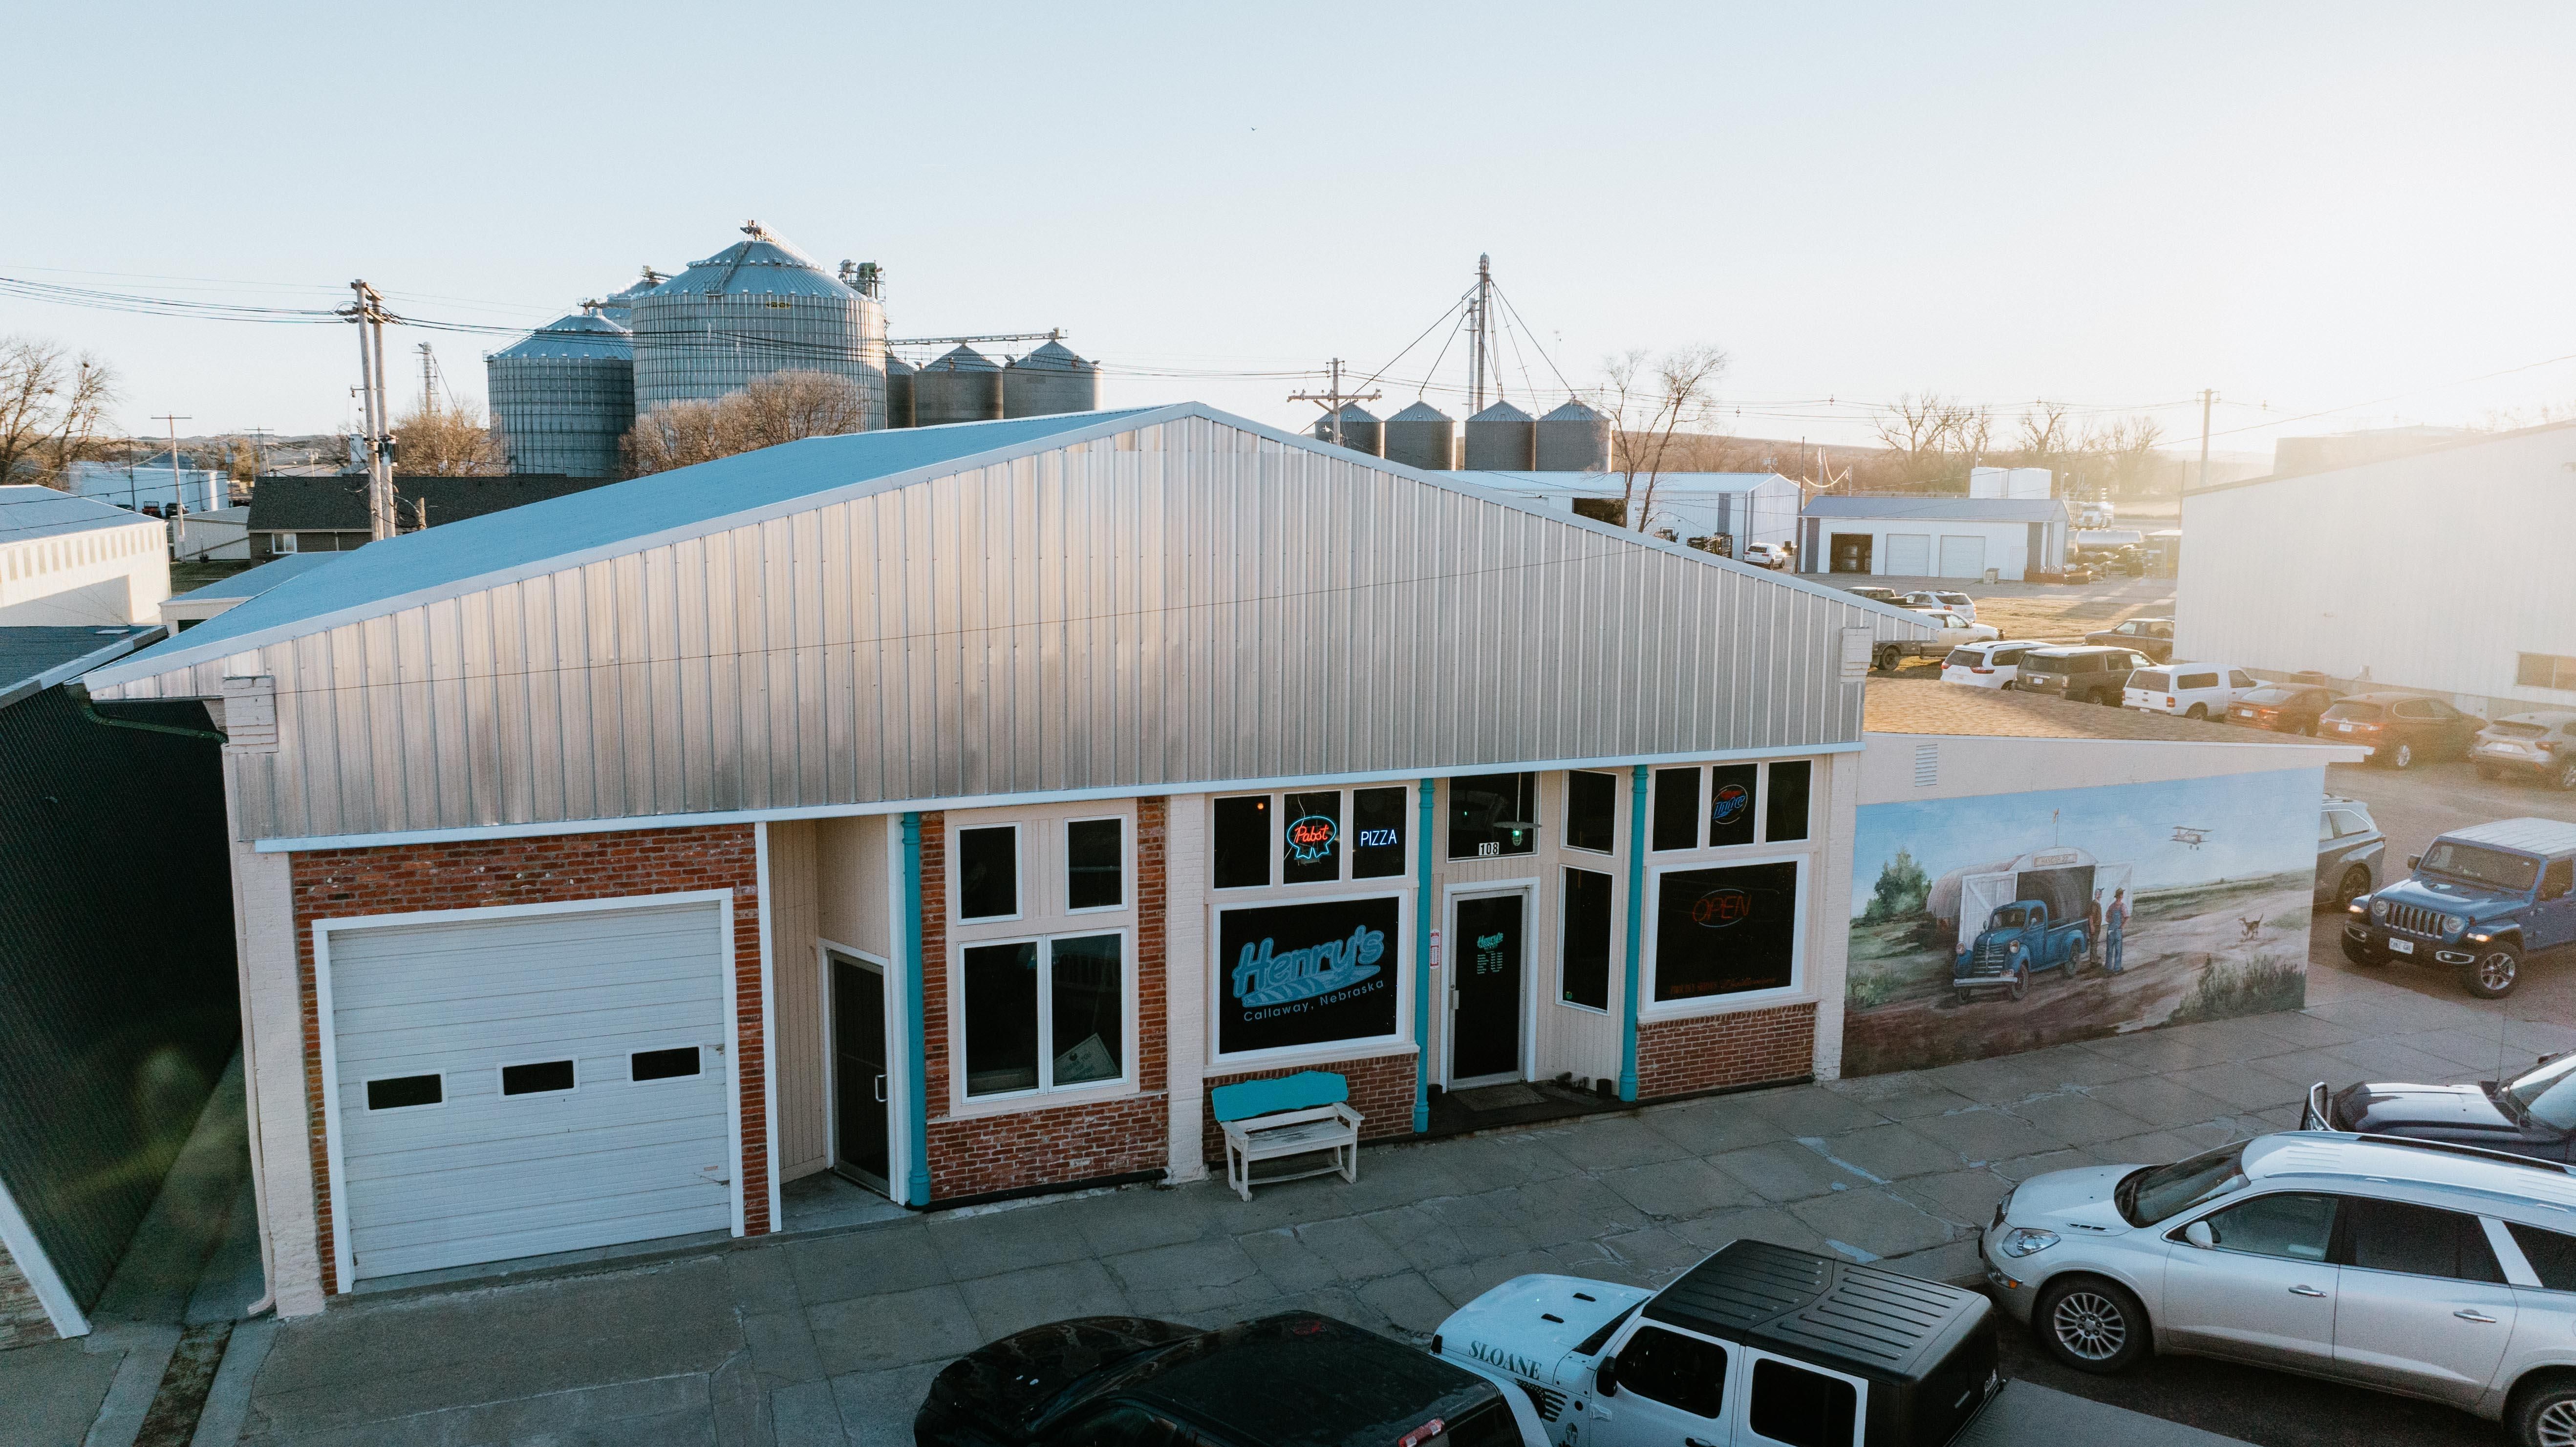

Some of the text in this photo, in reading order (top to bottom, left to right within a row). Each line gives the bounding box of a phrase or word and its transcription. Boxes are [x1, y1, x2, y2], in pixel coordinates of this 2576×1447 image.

[1295, 824, 1329, 843] Pabst
[1361, 829, 1397, 847] PIZZA
[1481, 843, 1498, 855] 108
[1692, 894, 1751, 923] OPEN
[1232, 925, 1384, 998] Henry's
[1244, 979, 1384, 1021] Callaway, Nebraska
[1469, 1340, 1542, 1380] SLOANE
